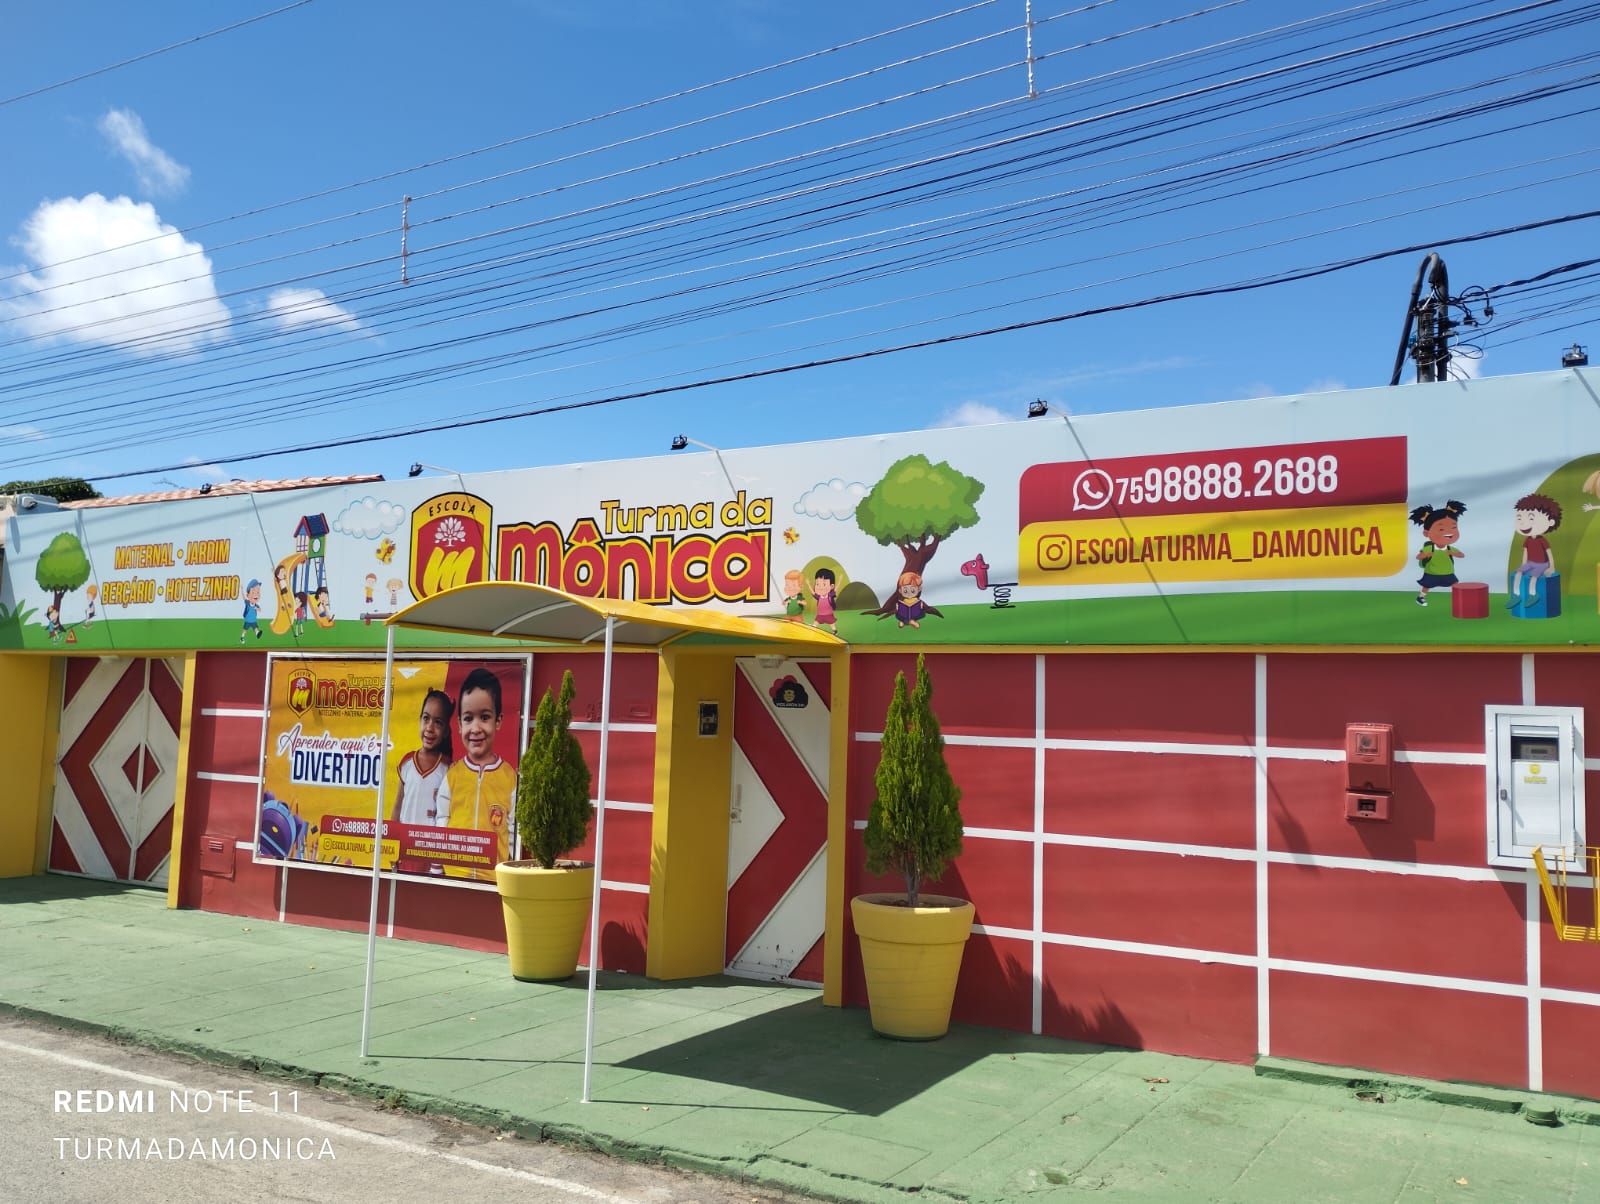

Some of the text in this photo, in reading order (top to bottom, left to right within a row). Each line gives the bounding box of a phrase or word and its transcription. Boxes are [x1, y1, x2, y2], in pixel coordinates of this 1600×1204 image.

[1116, 455, 1338, 504] 7598888.2688
[428, 500, 476, 517] ESCOLA
[600, 490, 773, 534] Turma da
[114, 539, 231, 570] MATERNAL JARDIM
[1076, 526, 1383, 565] ESCOLATURMA_DAMONICA
[101, 575, 240, 608] BERÇÁRIO HOTELZINHO
[280, 725, 338, 757] Aprender
[341, 738, 366, 761] aqui
[368, 736, 375, 751] é
